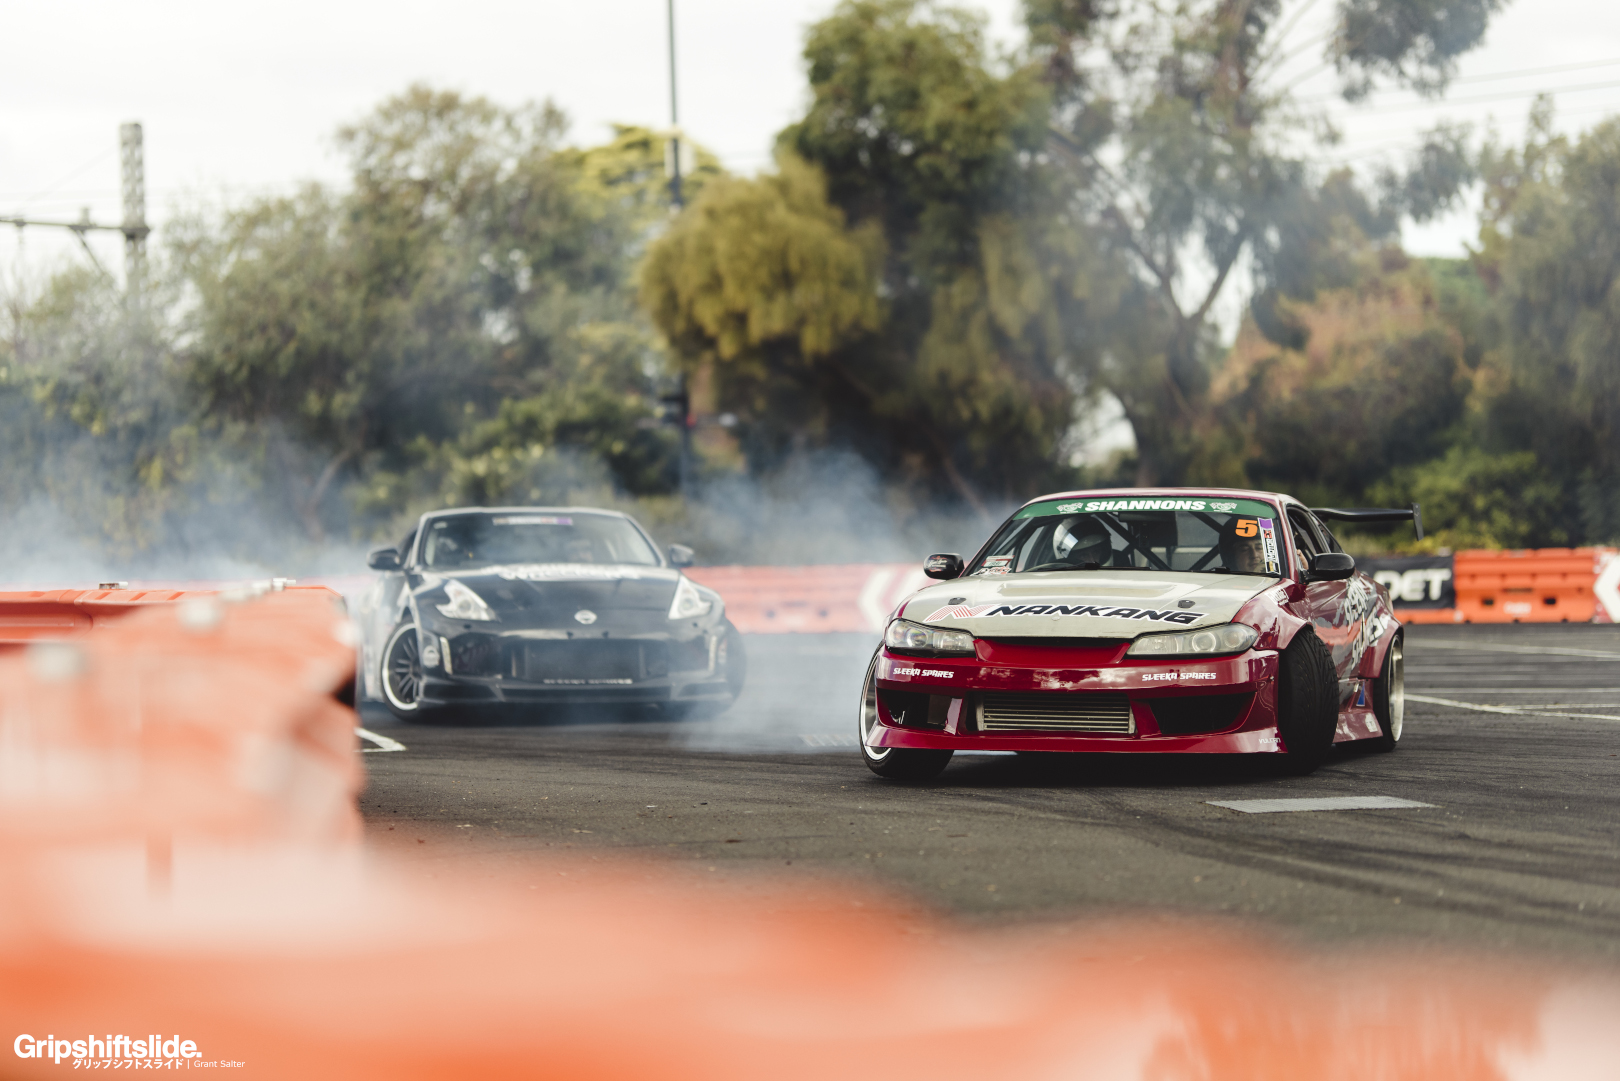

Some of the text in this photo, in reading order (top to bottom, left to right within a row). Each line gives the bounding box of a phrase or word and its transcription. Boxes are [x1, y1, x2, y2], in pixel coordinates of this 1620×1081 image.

[1085, 500, 1207, 511] SHANNONS
[1235, 519, 1258, 538] 5
[986, 605, 1203, 624] NANKANG
[893, 668, 954, 678] SLEEKA SPARES
[1142, 672, 1216, 681] SLEEKA SPARES
